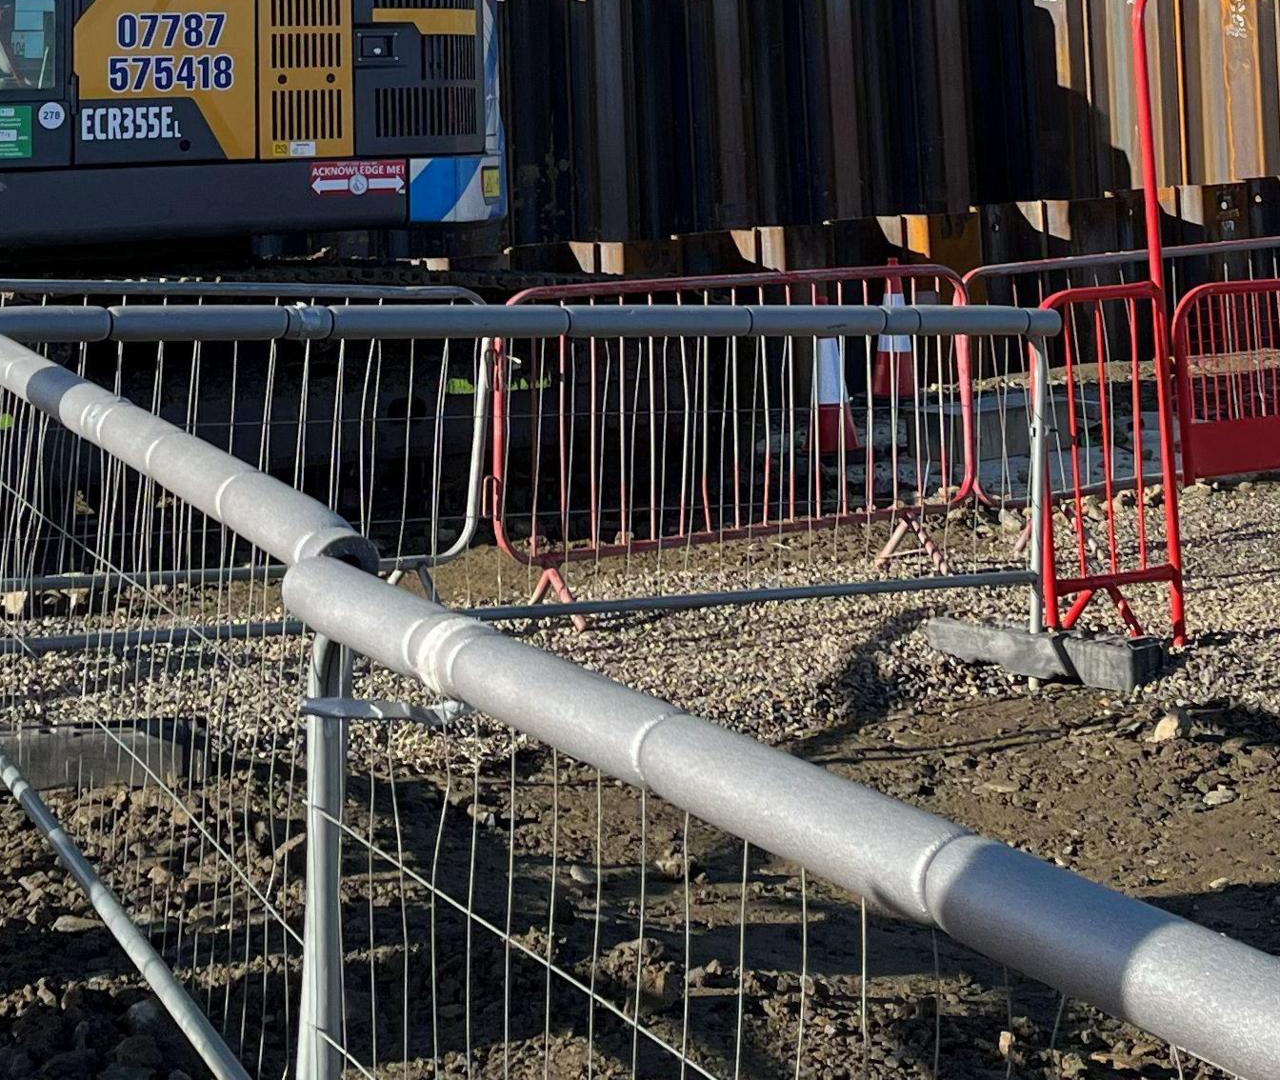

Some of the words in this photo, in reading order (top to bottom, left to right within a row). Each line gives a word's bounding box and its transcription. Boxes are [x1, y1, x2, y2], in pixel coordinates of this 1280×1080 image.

[117, 12, 227, 49] 07787
[108, 55, 234, 92] 575418
[42, 110, 61, 121] 278
[312, 165, 385, 177] ACKNOWLEDGE
[386, 165, 405, 175] ME!
